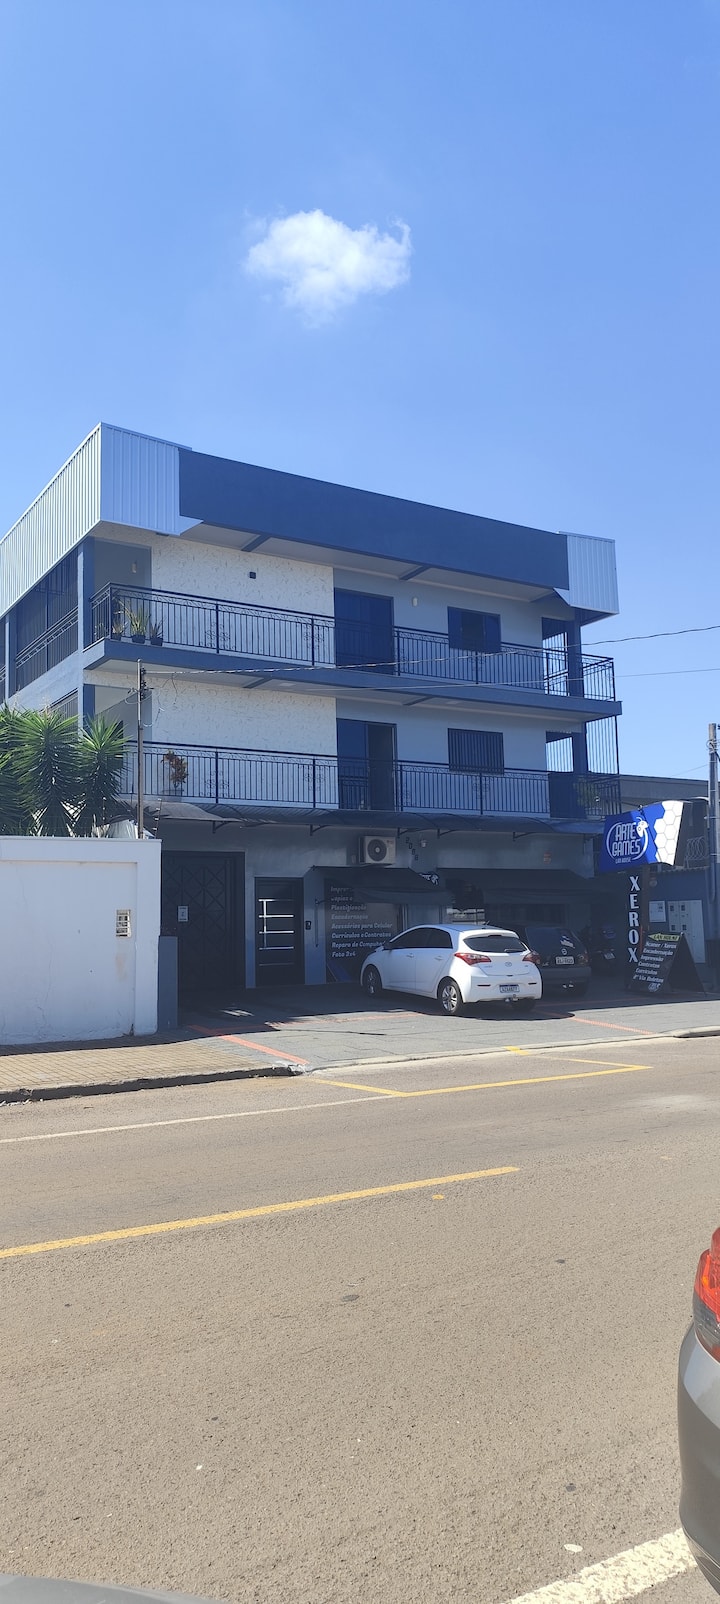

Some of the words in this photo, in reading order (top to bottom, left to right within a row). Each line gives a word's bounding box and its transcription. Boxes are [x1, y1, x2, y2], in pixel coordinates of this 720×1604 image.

[615, 822, 637, 841] ARTE
[611, 839, 641, 857] GAMES
[331, 913, 369, 921] Encadernação
[628, 876, 640, 963] XEROX
[331, 922, 360, 930] Acessórios
[360, 923, 373, 931] para
